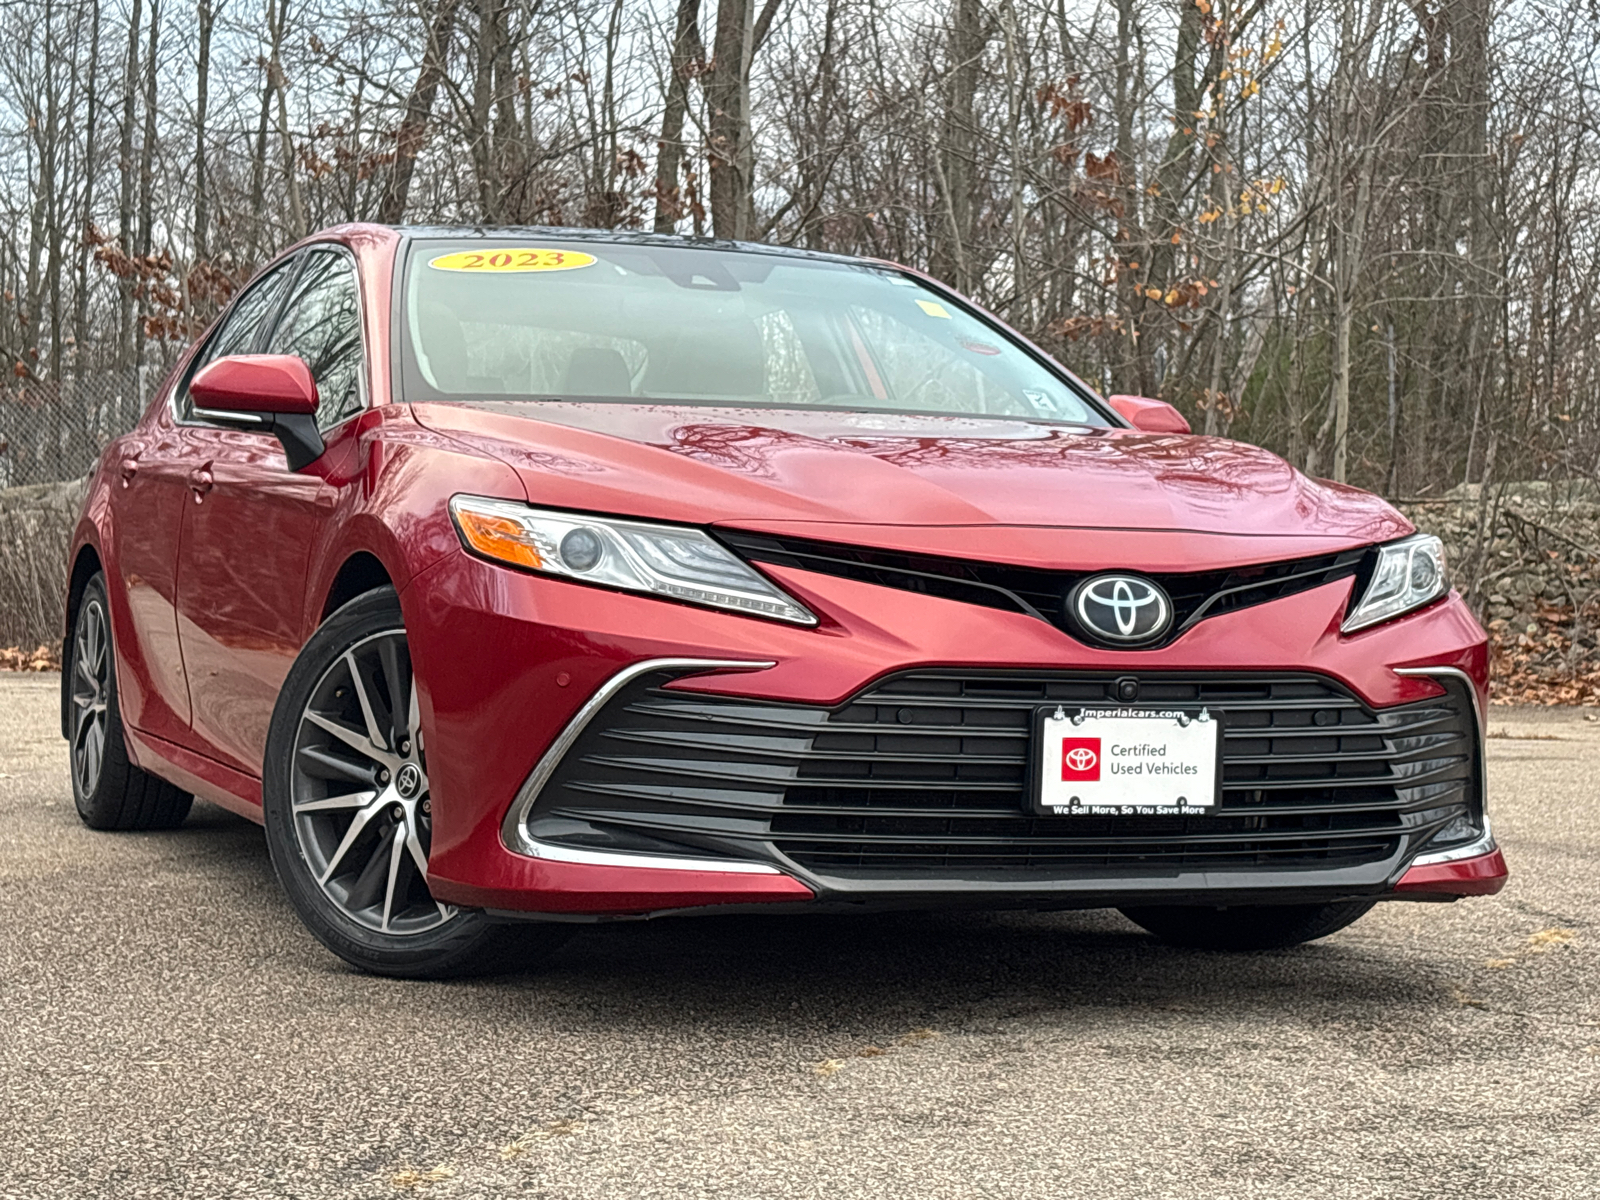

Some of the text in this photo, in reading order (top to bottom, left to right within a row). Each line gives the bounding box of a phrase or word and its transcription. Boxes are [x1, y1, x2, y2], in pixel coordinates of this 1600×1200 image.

[462, 252, 565, 269] 2023
[1079, 708, 1185, 720] Imperialcars.com
[1110, 743, 1167, 757] Certified
[1110, 762, 1198, 775] Used Vehicles
[1053, 805, 1205, 816] We Sell More, So You Save More
